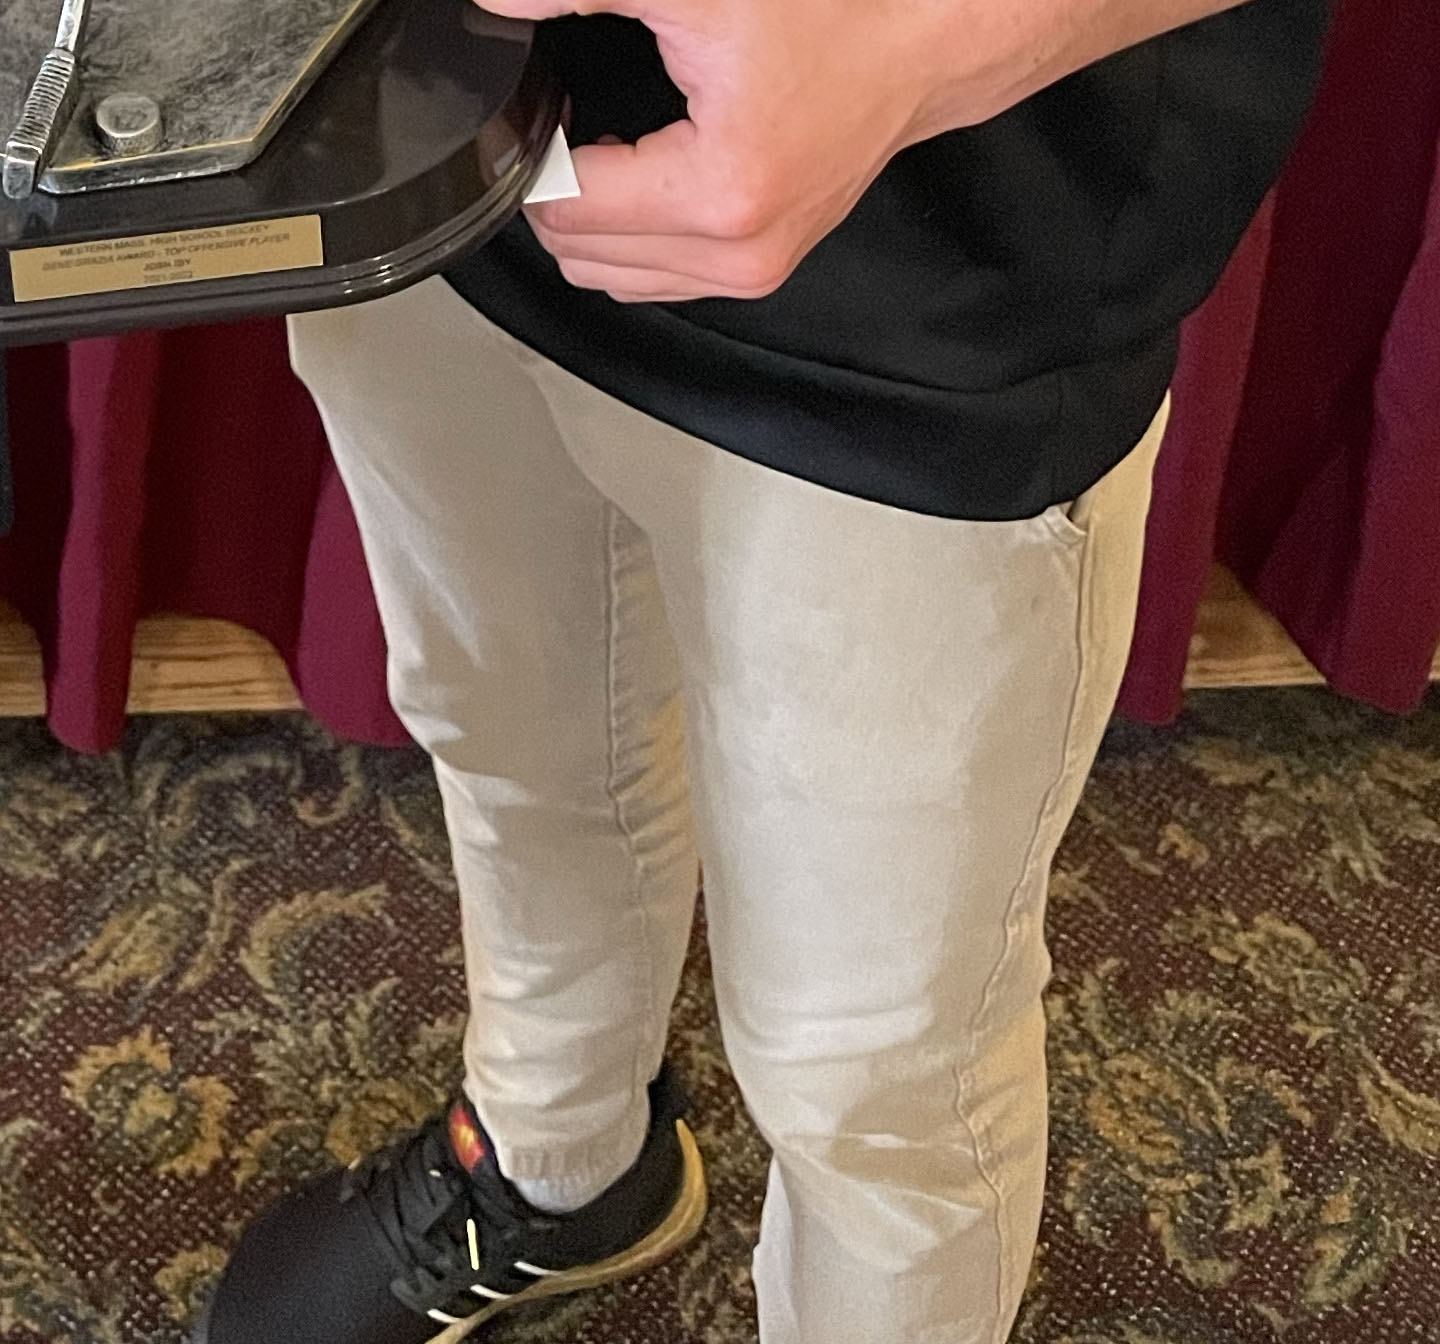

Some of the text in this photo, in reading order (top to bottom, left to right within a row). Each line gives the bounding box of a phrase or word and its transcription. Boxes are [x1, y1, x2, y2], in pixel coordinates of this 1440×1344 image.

[59, 241, 113, 256] WESTERN
[149, 234, 177, 246] HIGH
[178, 229, 222, 242] SCHOOL
[225, 224, 269, 236] HOCKEY
[116, 250, 155, 262] AWARD
[164, 245, 187, 256] TOP
[188, 238, 246, 253] OFFENSIVE
[248, 232, 290, 246] PLAYER
